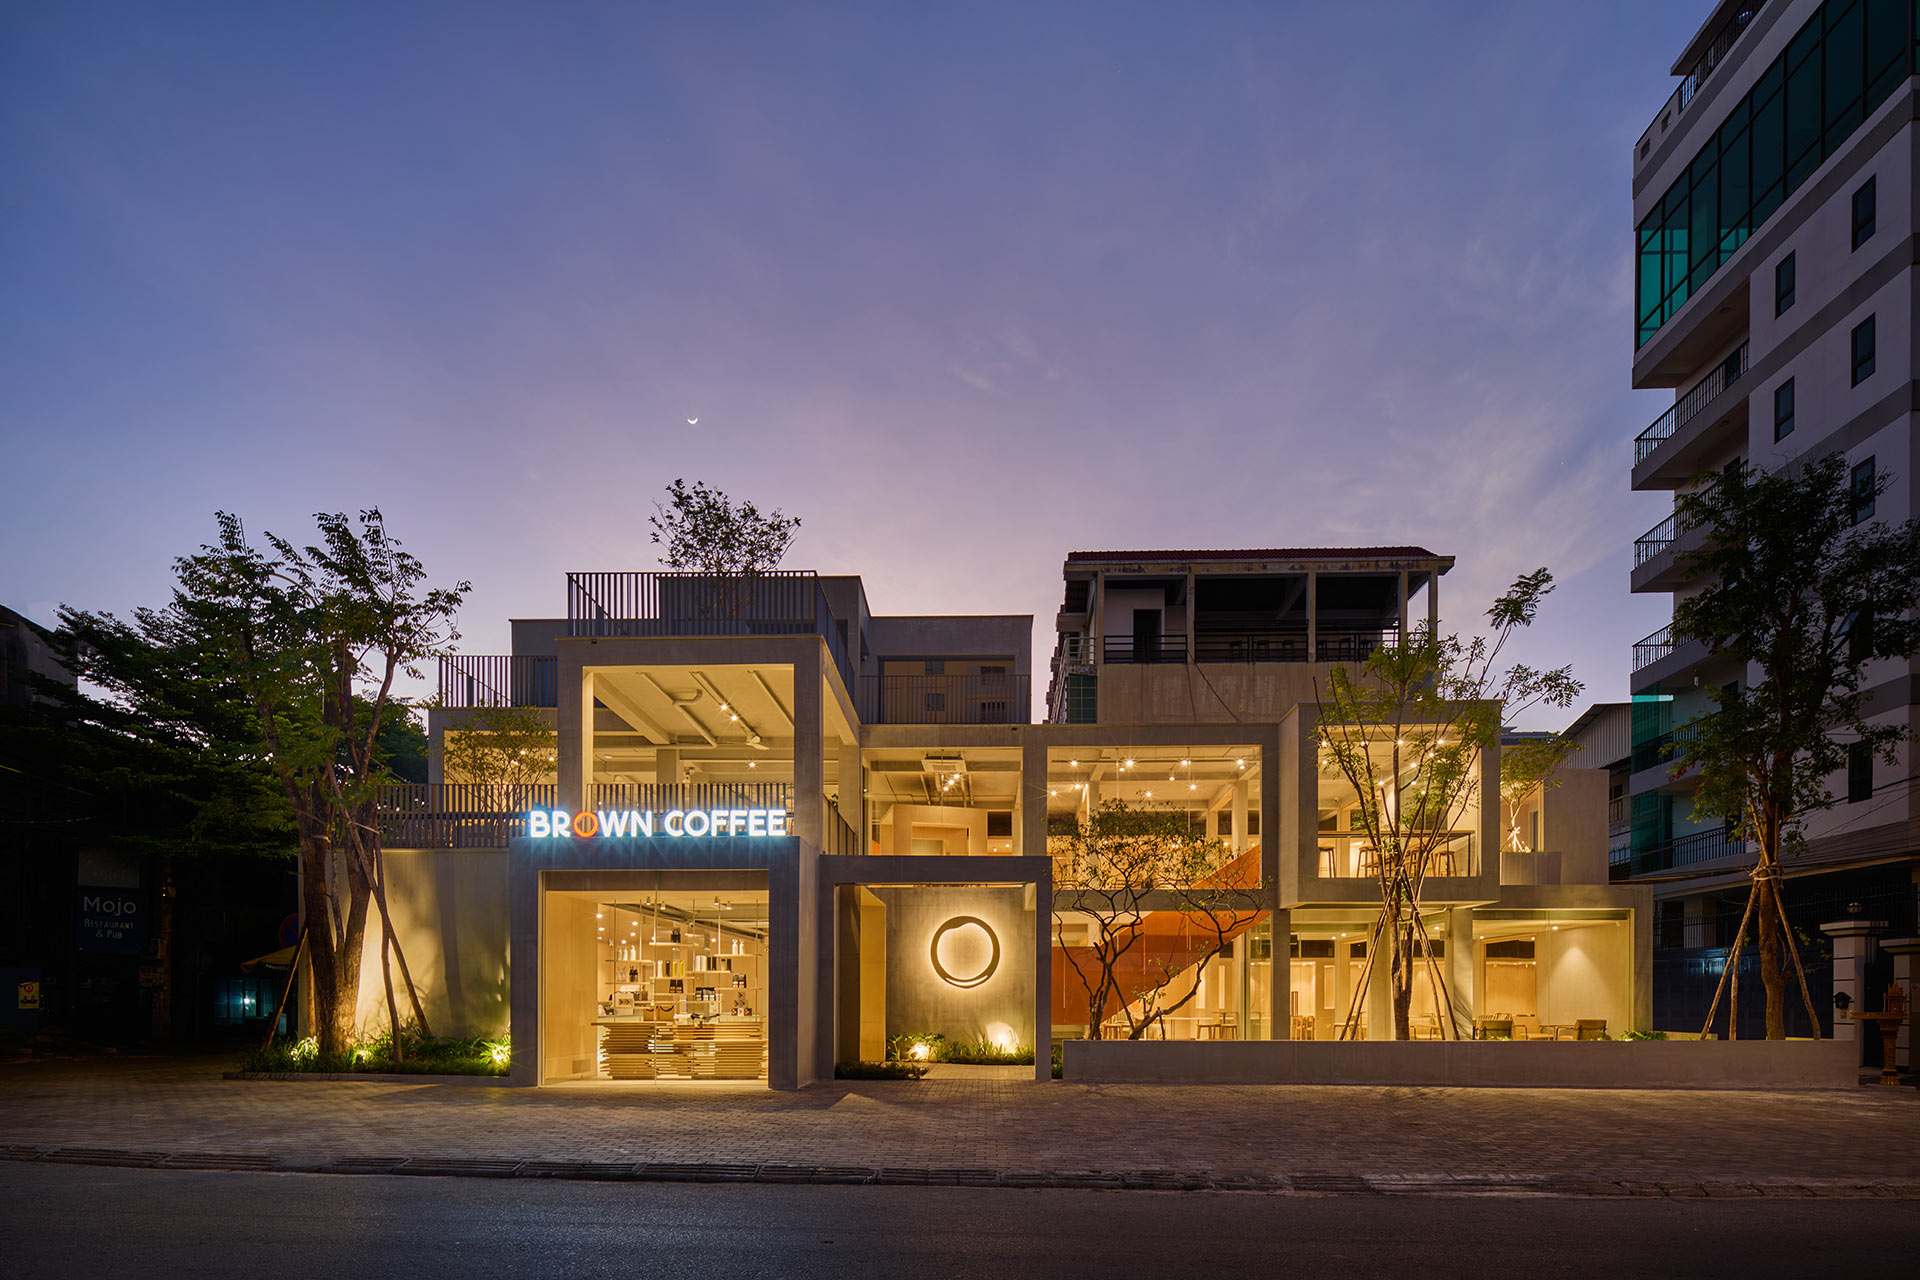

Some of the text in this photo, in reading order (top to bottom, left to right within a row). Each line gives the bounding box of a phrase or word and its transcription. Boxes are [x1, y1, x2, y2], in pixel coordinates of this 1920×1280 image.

[530, 809, 786, 837] BROWN COFFEE
[83, 896, 136, 916] Mojo
[95, 929, 104, 938] &
